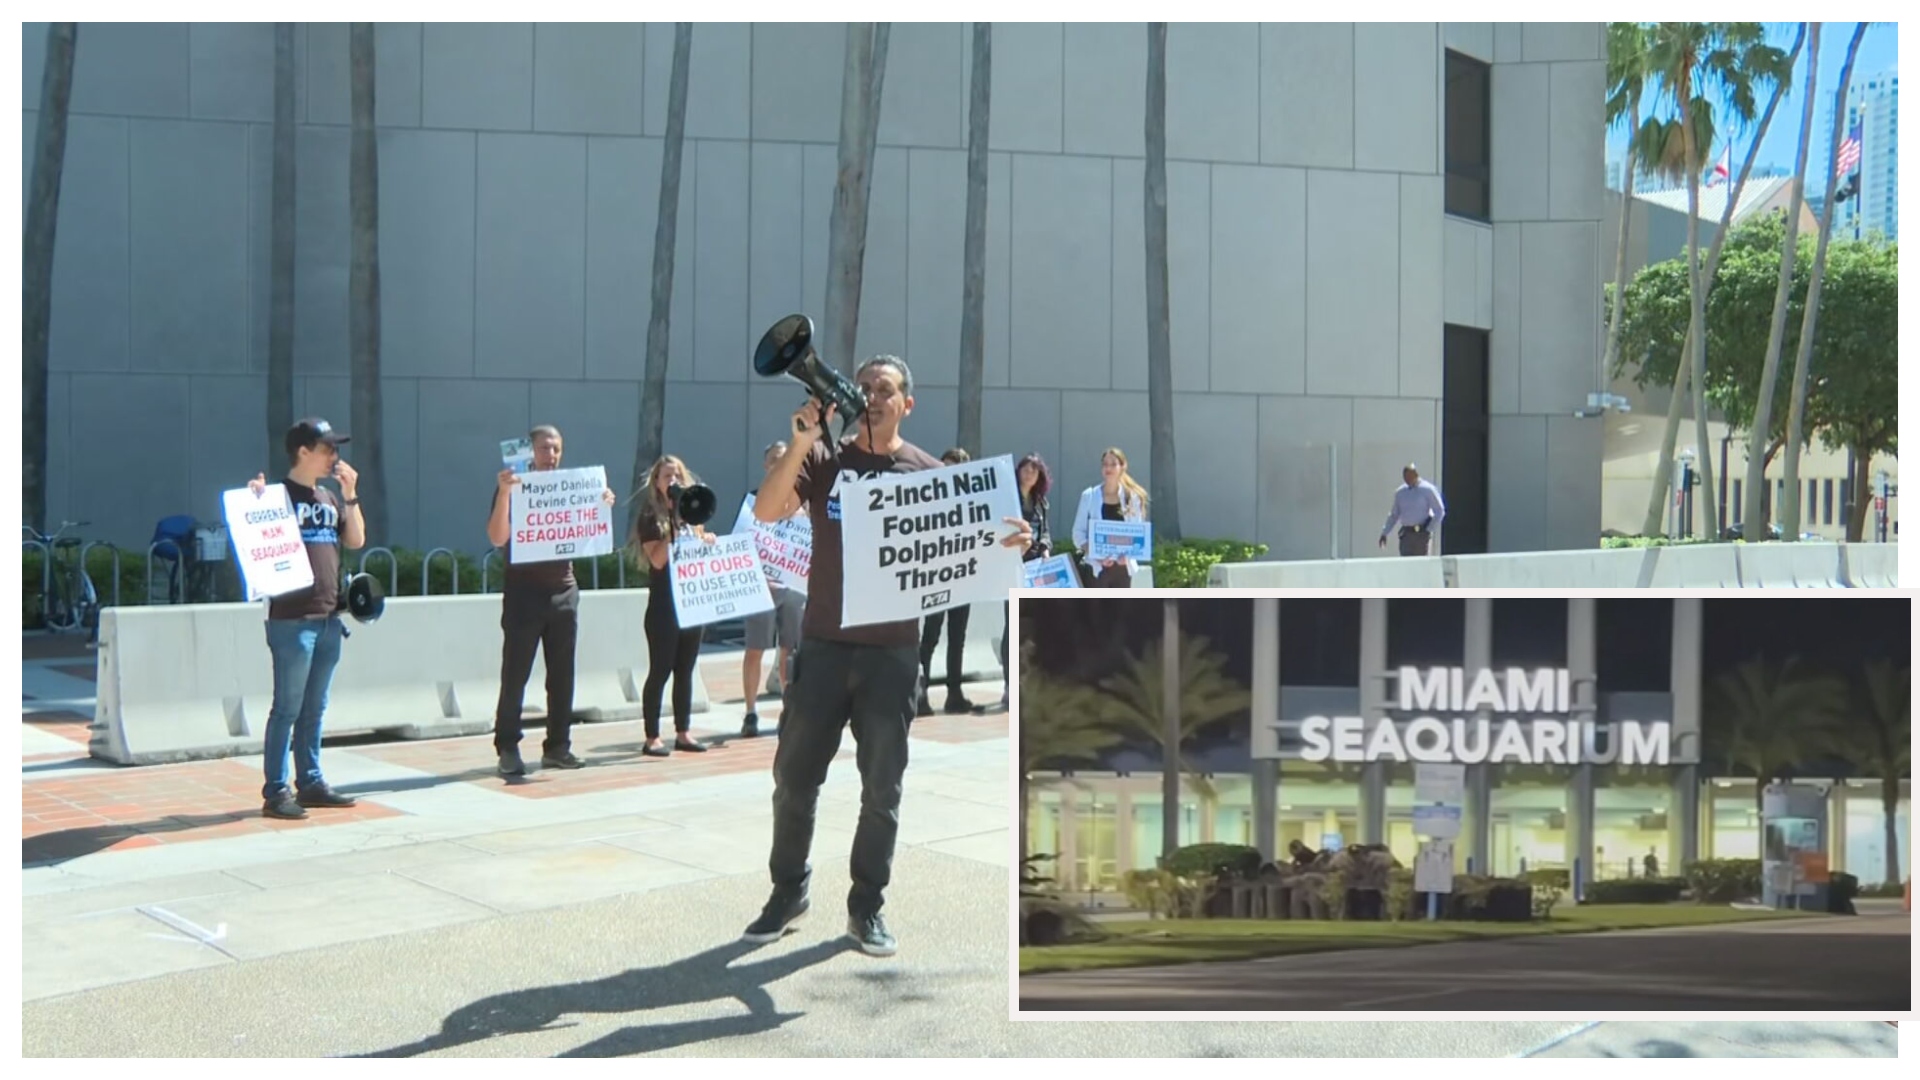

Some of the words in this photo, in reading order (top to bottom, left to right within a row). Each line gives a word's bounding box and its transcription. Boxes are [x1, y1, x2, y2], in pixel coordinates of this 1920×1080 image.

[521, 482, 558, 495] Mayor
[561, 477, 602, 492] Daniella
[868, 477, 949, 512] 2-Inch
[952, 467, 997, 497] Nail
[528, 495, 566, 509] Levine
[526, 510, 572, 527] CLOSE
[576, 507, 599, 521] THE
[883, 507, 963, 538] Found
[969, 501, 991, 524] in
[516, 523, 608, 543] SEAQUARIUM
[749, 529, 788, 553] LOSE
[675, 544, 722, 560] ANIMALS
[725, 540, 749, 554] ARE
[677, 561, 705, 579] NOT
[710, 554, 753, 573] OURS
[896, 557, 978, 591] Throat
[679, 581, 697, 595] TO
[700, 576, 727, 592] USE
[730, 570, 758, 586] FOR
[681, 584, 762, 608] ENTERTAINMENT
[1398, 665, 1571, 713] MIAMI
[1298, 714, 1672, 765] SEAQUARIUM
